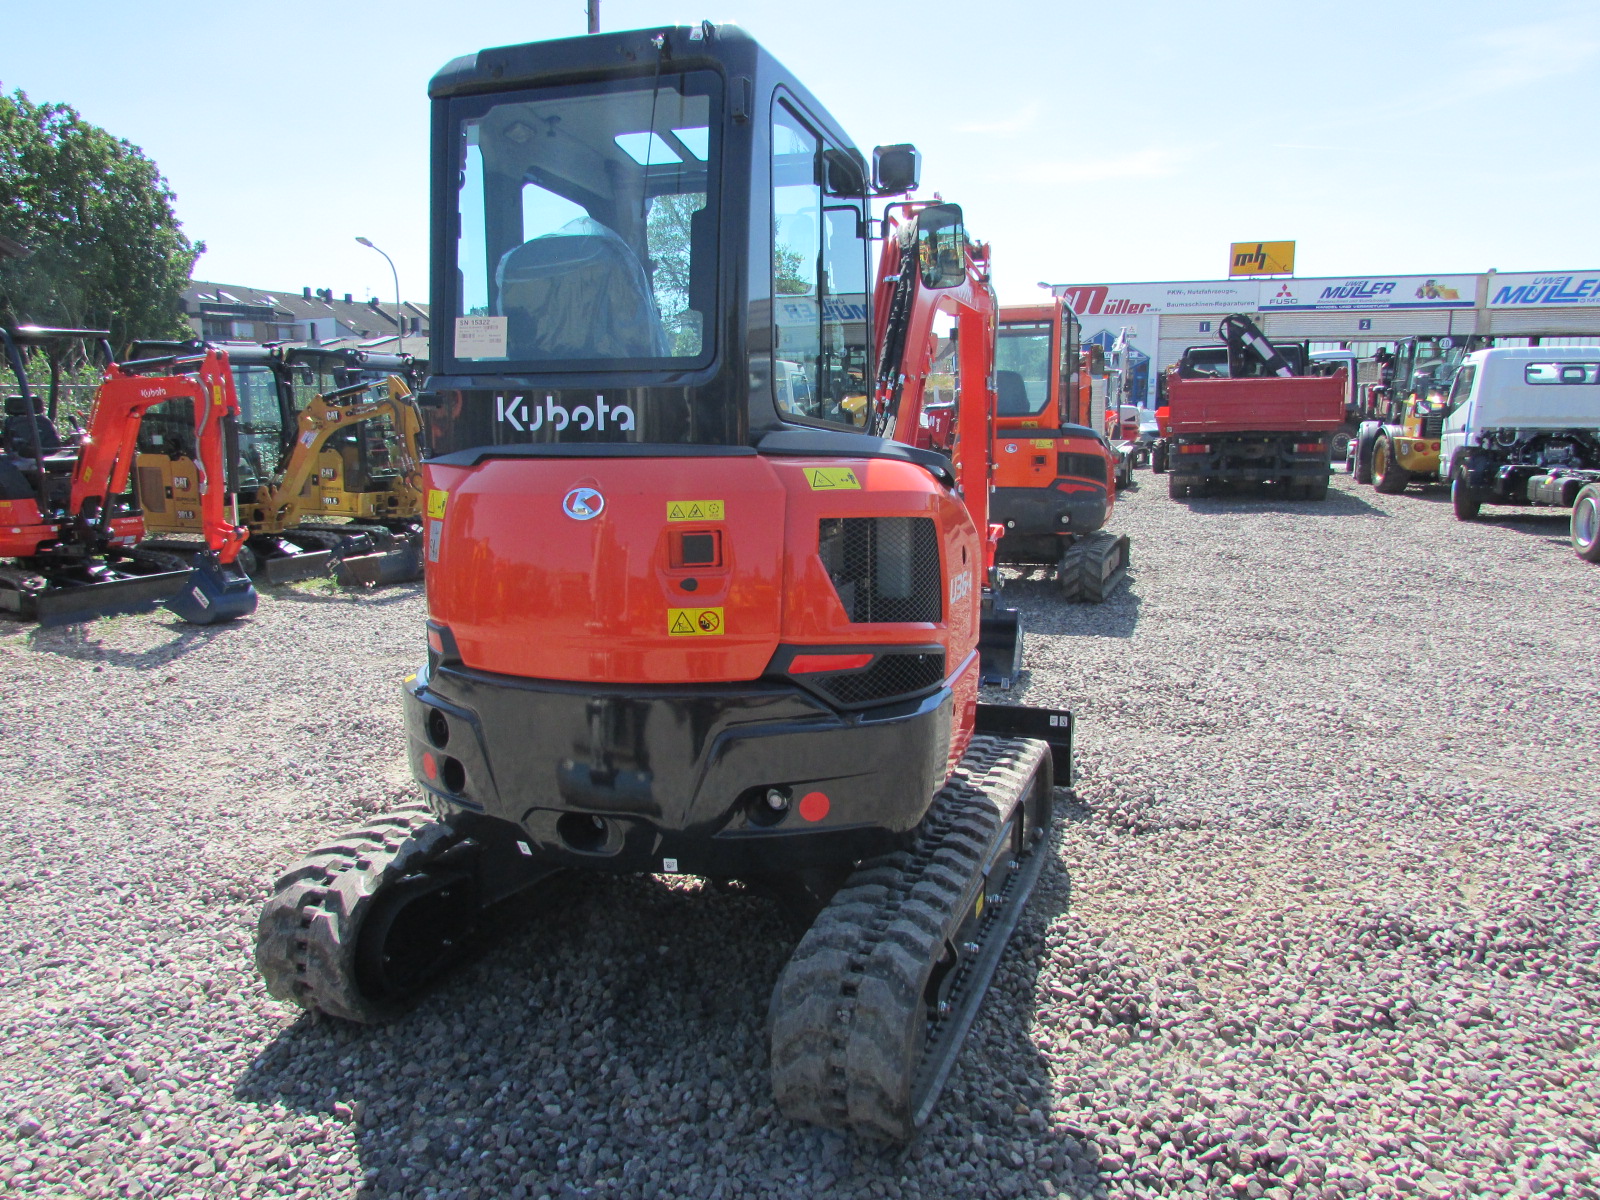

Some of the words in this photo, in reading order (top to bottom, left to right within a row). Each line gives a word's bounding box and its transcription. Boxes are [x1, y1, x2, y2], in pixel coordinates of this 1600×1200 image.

[1533, 276, 1565, 285] UWE
[1361, 321, 1368, 329] 2
[140, 387, 167, 398] Kubota
[326, 410, 339, 421] CAT
[496, 395, 635, 431] Kubota
[321, 468, 334, 478] CAT
[174, 477, 188, 489] CAT
